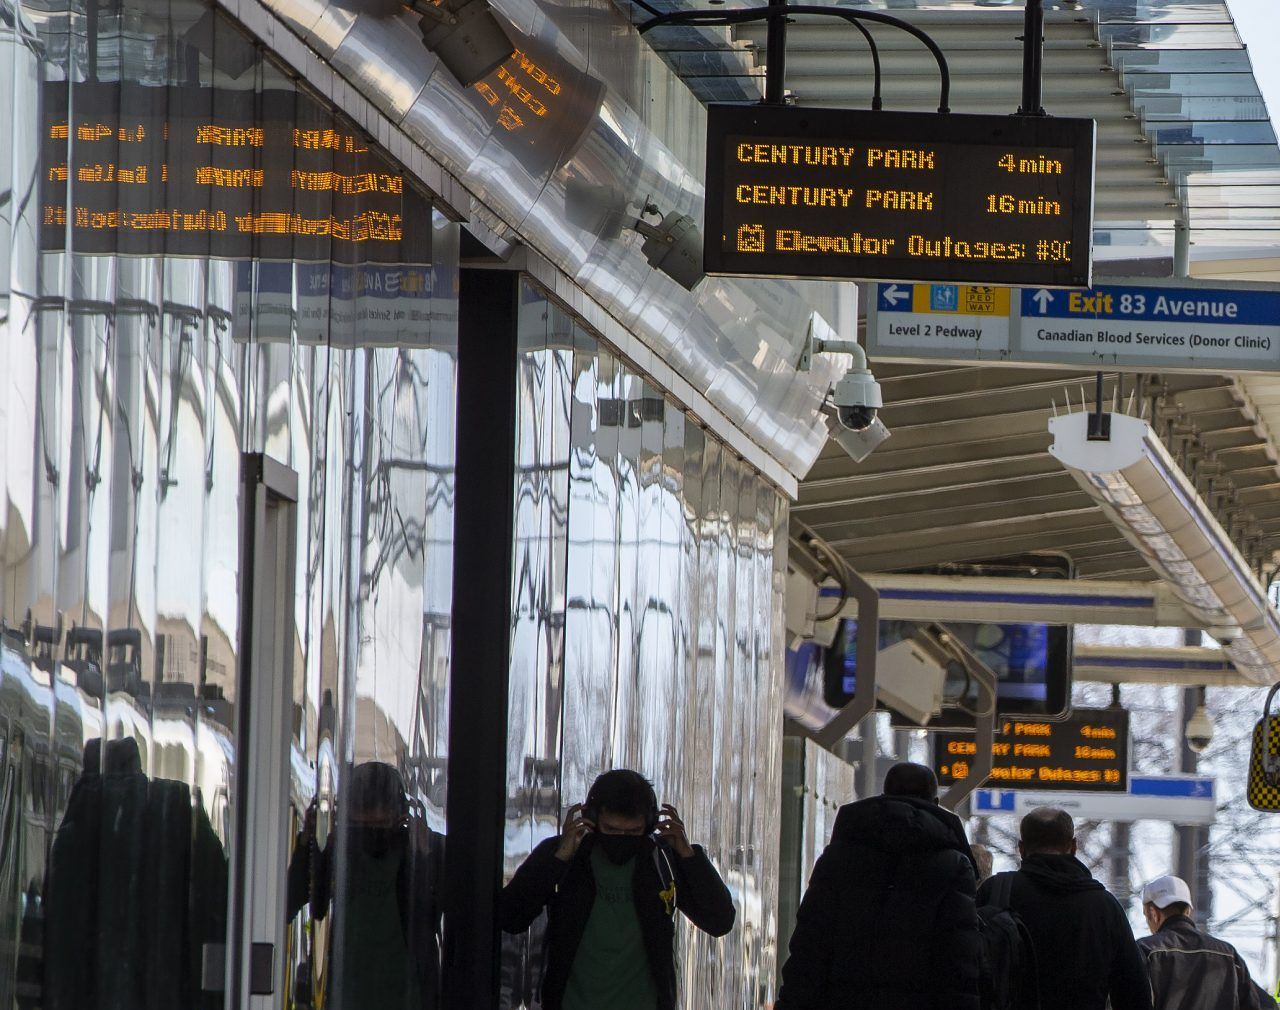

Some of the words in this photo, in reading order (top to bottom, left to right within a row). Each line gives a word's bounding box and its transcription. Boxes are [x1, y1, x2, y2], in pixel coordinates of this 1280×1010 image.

[737, 143, 854, 166] CENTURY
[867, 148, 934, 170] PARK
[735, 184, 853, 207] CENTURY
[866, 190, 933, 210] PARK
[986, 194, 1061, 215] 16min
[775, 229, 895, 255] Elevator
[1068, 291, 1113, 314] Exit
[1119, 294, 1146, 315] 83
[1152, 295, 1238, 318] Avenue
[889, 323, 920, 336] Level
[924, 324, 931, 336] 2
[935, 325, 982, 341] Pedway
[1037, 329, 1093, 342] Canadian
[1097, 331, 1131, 343] Blood
[1135, 333, 1185, 346] Services
[1189, 334, 1230, 349] (Donor
[1234, 336, 1271, 351] Clinic)
[947, 741, 1011, 756] CENRY
